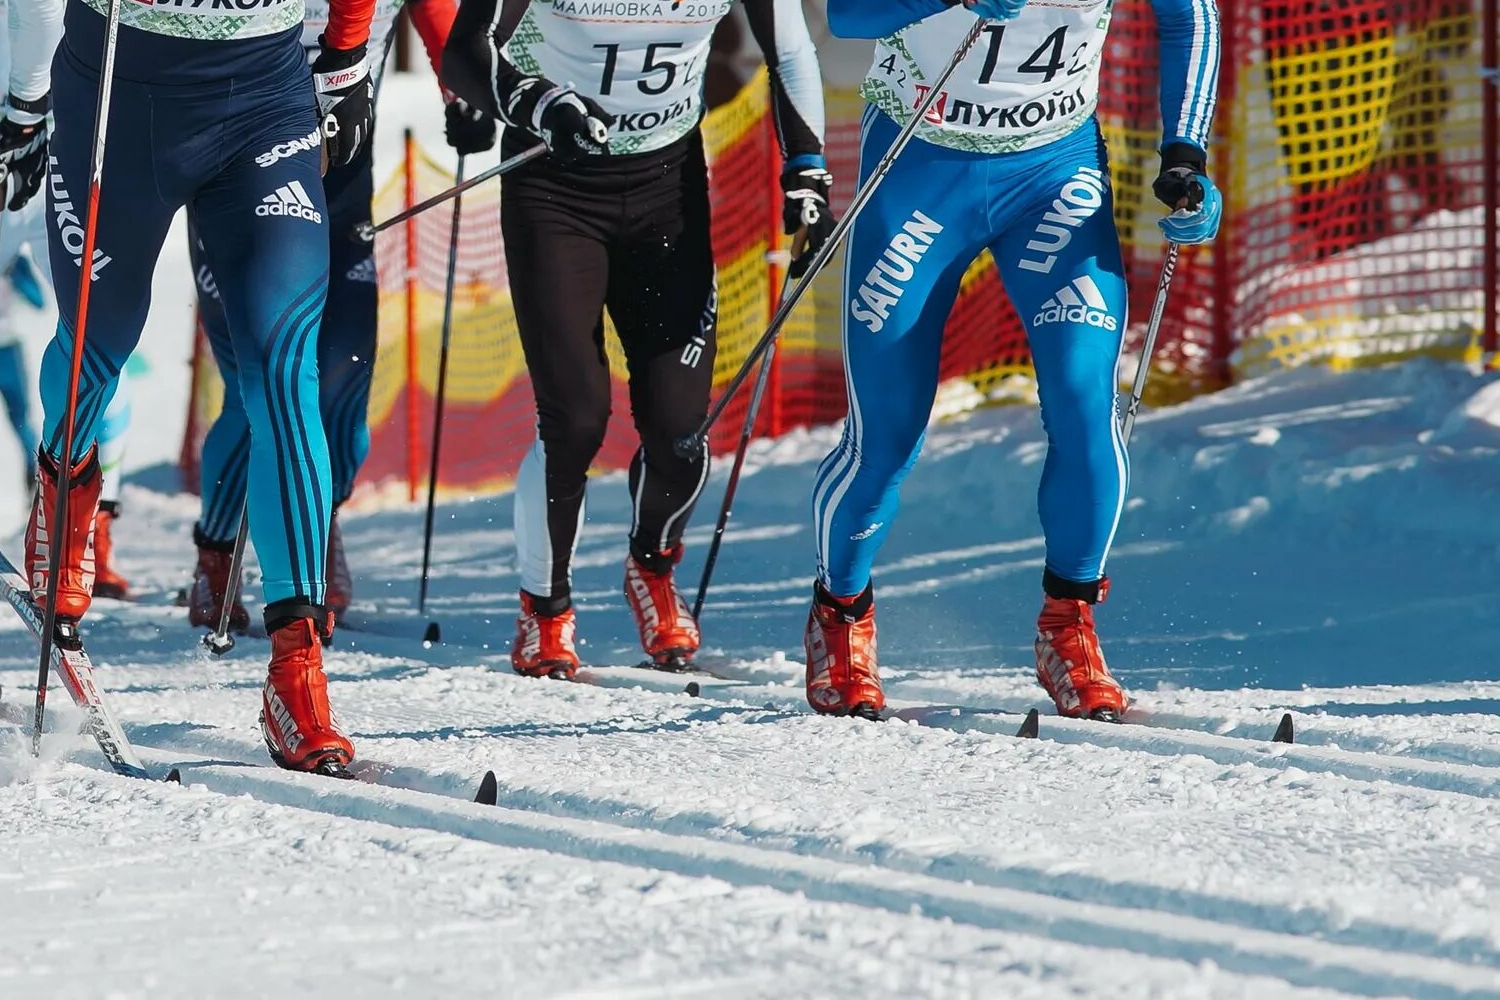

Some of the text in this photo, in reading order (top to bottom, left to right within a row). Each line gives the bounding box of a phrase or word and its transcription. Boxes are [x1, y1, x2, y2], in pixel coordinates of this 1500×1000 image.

[552, 0, 728, 17] МАЛИНОВКА 2015
[593, 42, 684, 96] 15
[978, 25, 1069, 84] 14
[612, 96, 691, 132] КОЙЛ
[945, 86, 1086, 129] ЛУКОЙЛ
[48, 153, 113, 283] LUKOIL
[255, 200, 322, 224] adidas
[851, 209, 944, 333] SATURN
[1033, 304, 1117, 331] adidas
